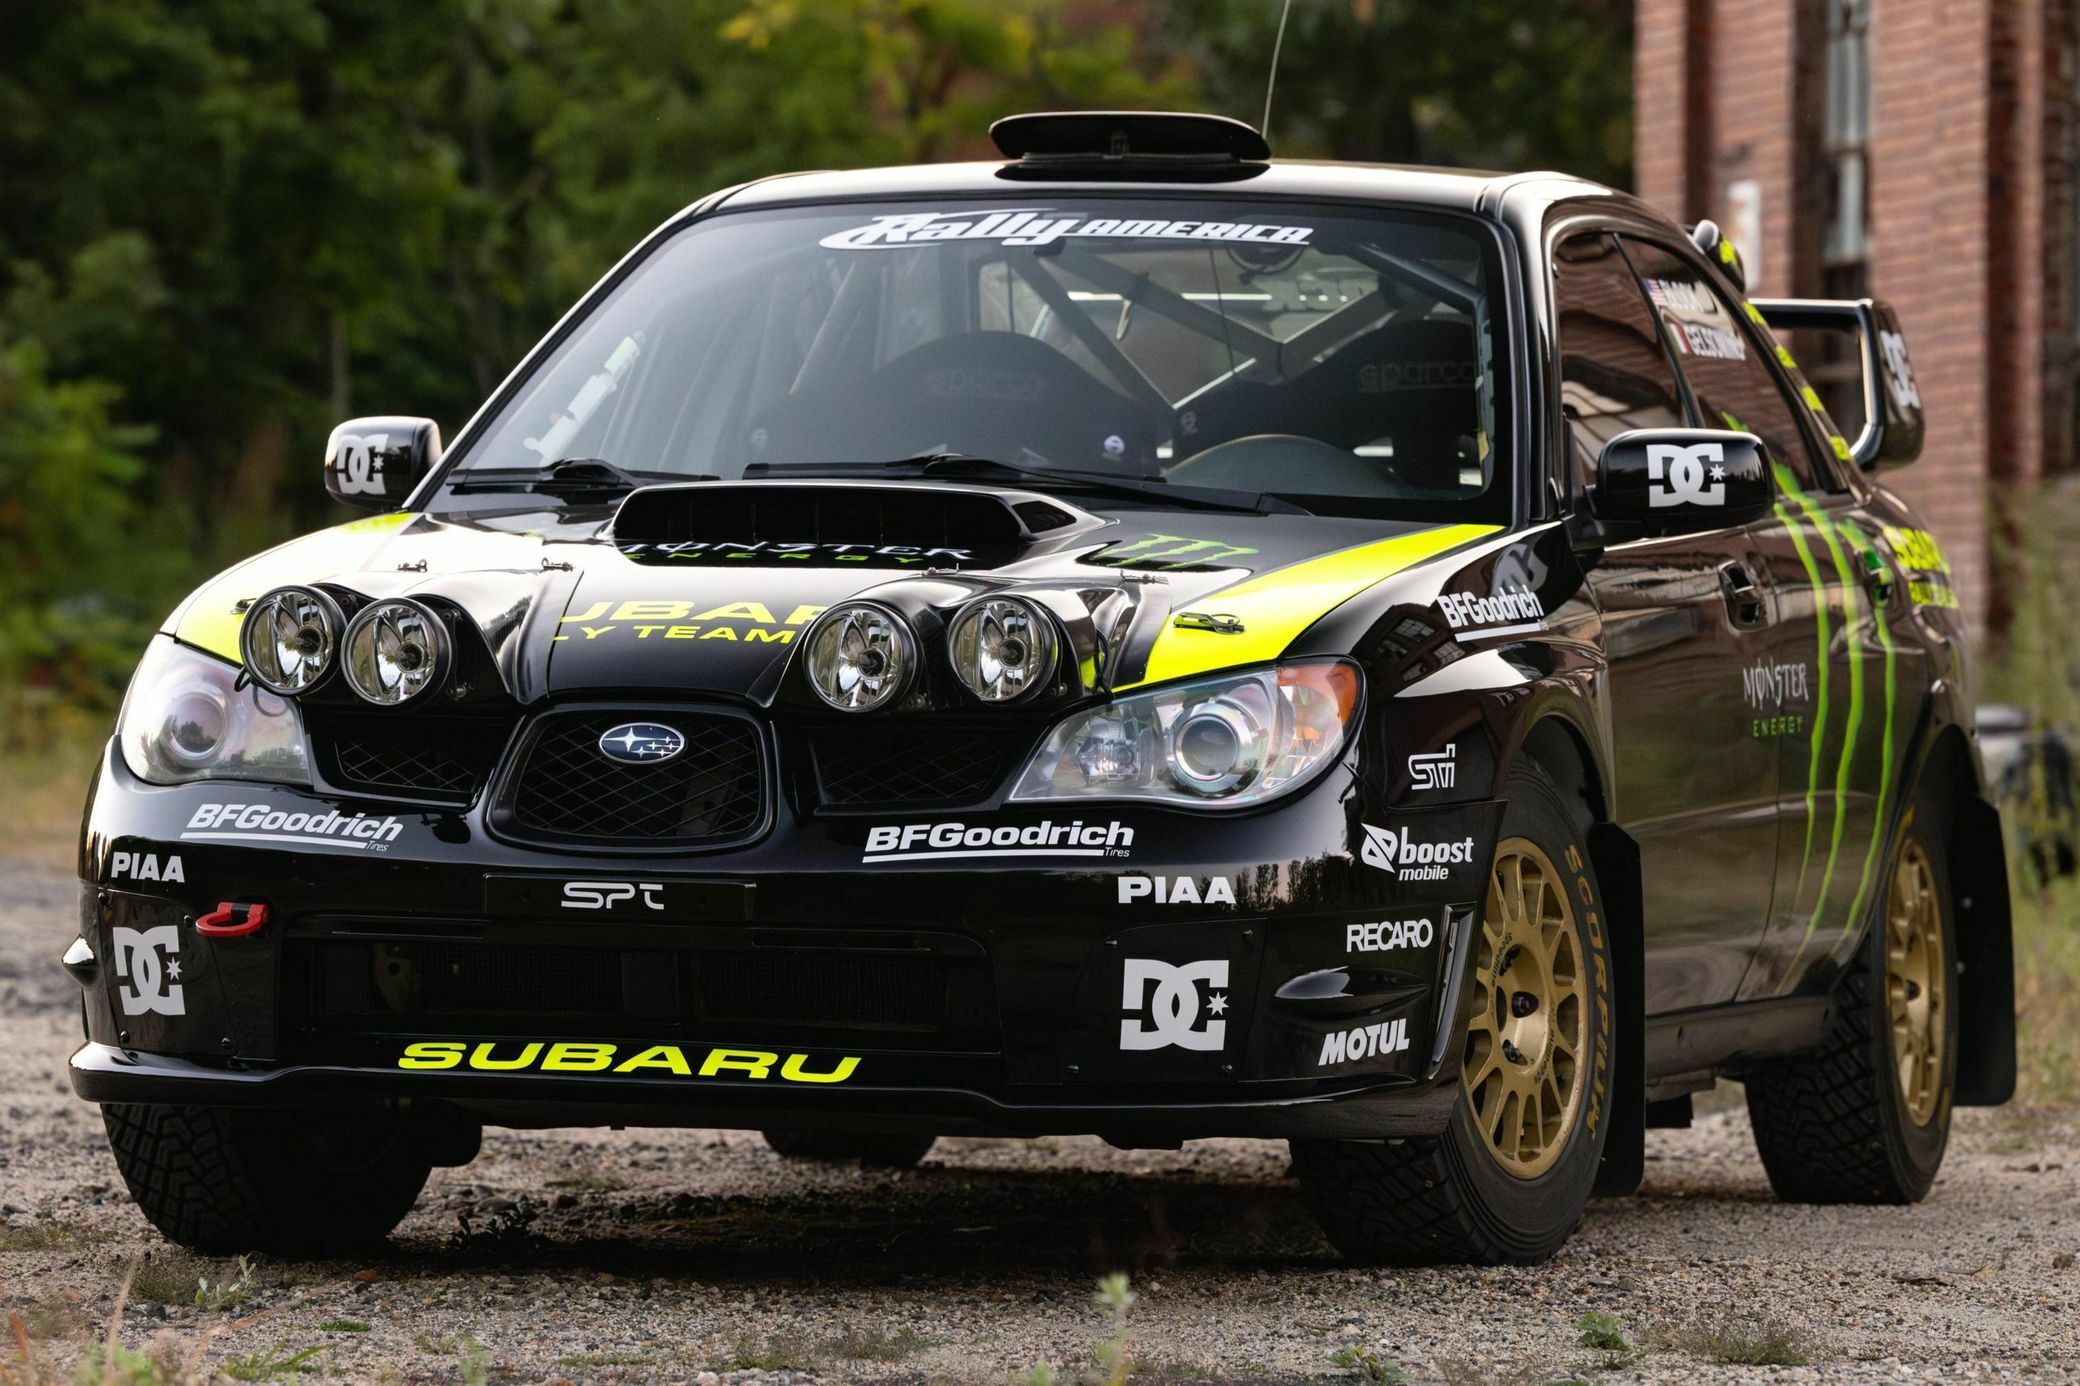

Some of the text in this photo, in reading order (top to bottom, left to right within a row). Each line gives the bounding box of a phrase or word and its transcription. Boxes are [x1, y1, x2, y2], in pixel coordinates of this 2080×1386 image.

[848, 211, 1314, 247] Rally AMERICA
[336, 433, 389, 495] DC
[1645, 442, 1726, 508] DC
[1437, 583, 1544, 629] BFGoodrich
[632, 624, 797, 644] TEAM
[1753, 715, 1804, 738] ENERGY
[186, 804, 404, 842] BFGoodrich
[864, 820, 1135, 853] BFGoodrich
[366, 840, 389, 852] Tires
[1104, 846, 1130, 857] Tires
[1398, 826, 1474, 864] boost
[111, 851, 185, 883] PIAA
[1398, 865, 1449, 881] mobile
[1117, 876, 1237, 904] PIAA
[1346, 918, 1434, 953] RECARO
[112, 925, 186, 1016] DC
[1119, 958, 1230, 1051] DC
[1318, 1018, 1410, 1066] MOTUL
[398, 1042, 862, 1083] SUBARU
